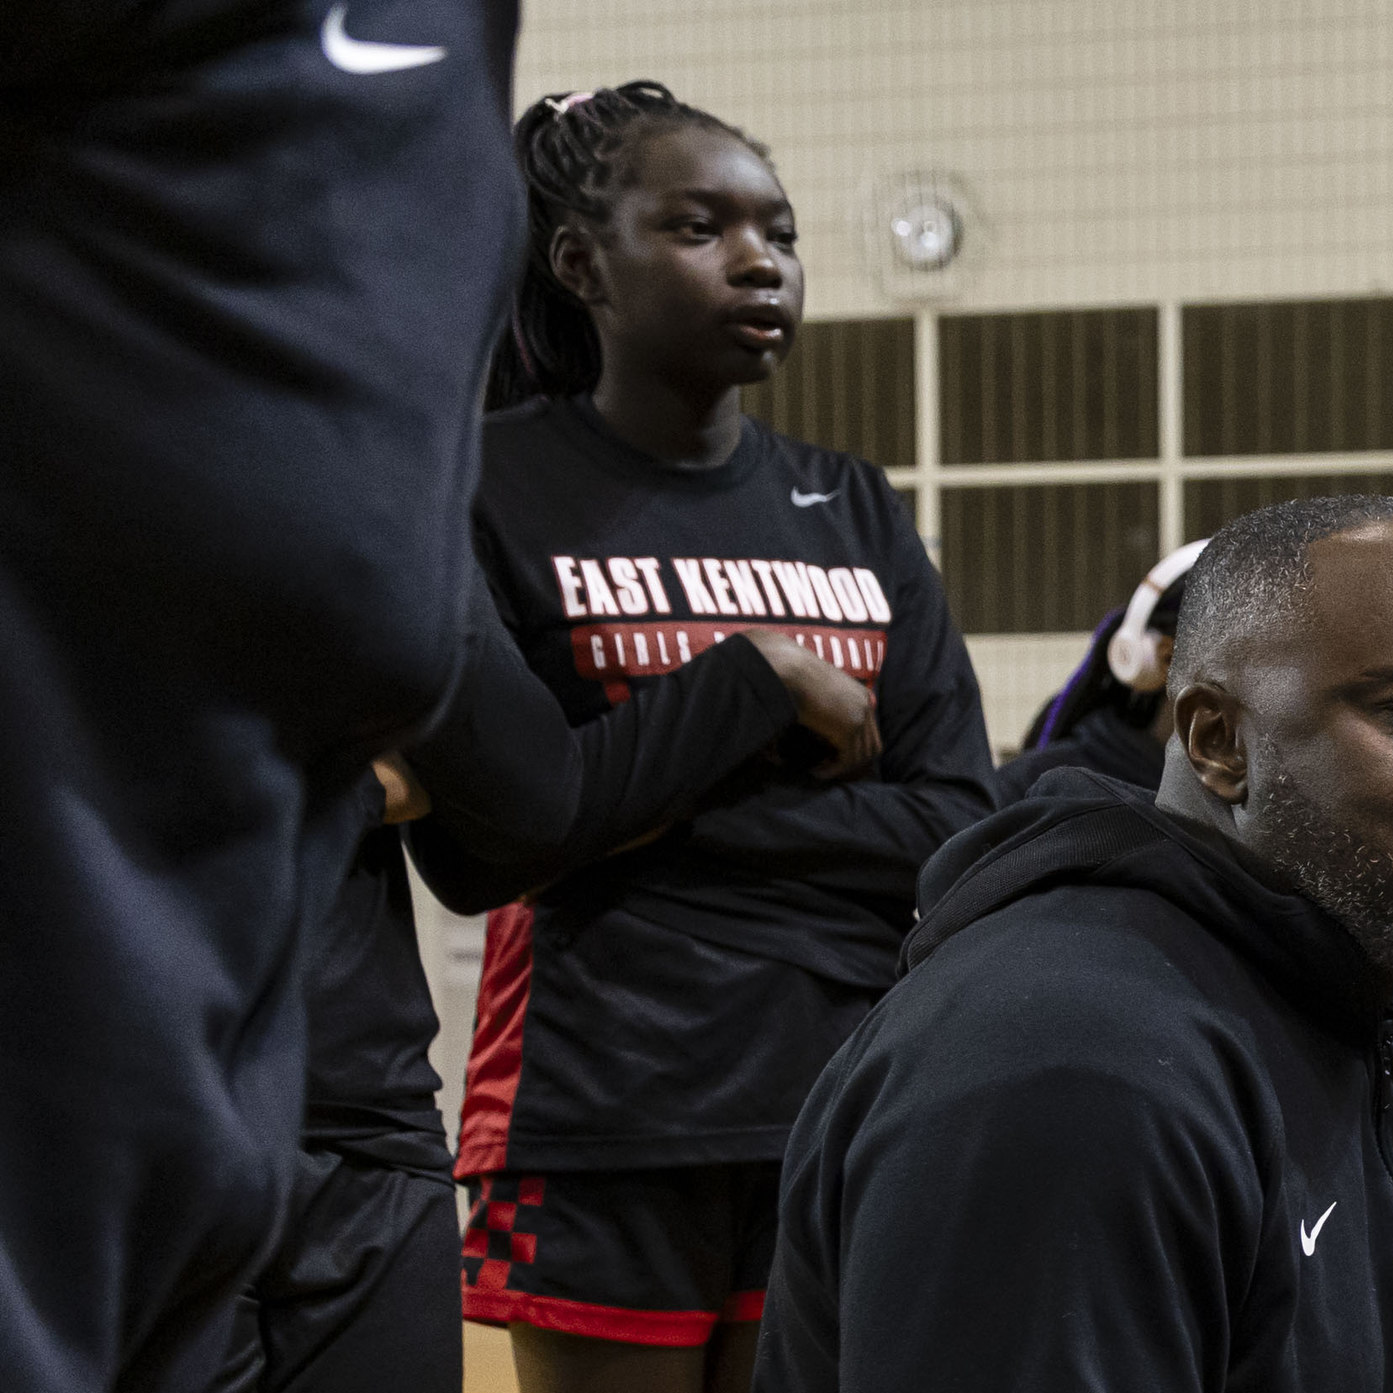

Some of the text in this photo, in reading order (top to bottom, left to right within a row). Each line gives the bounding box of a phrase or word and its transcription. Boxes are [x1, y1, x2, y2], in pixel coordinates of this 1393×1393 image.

[552, 554, 892, 624] EAST KENTWOOD
[590, 630, 693, 670] GIRLS
